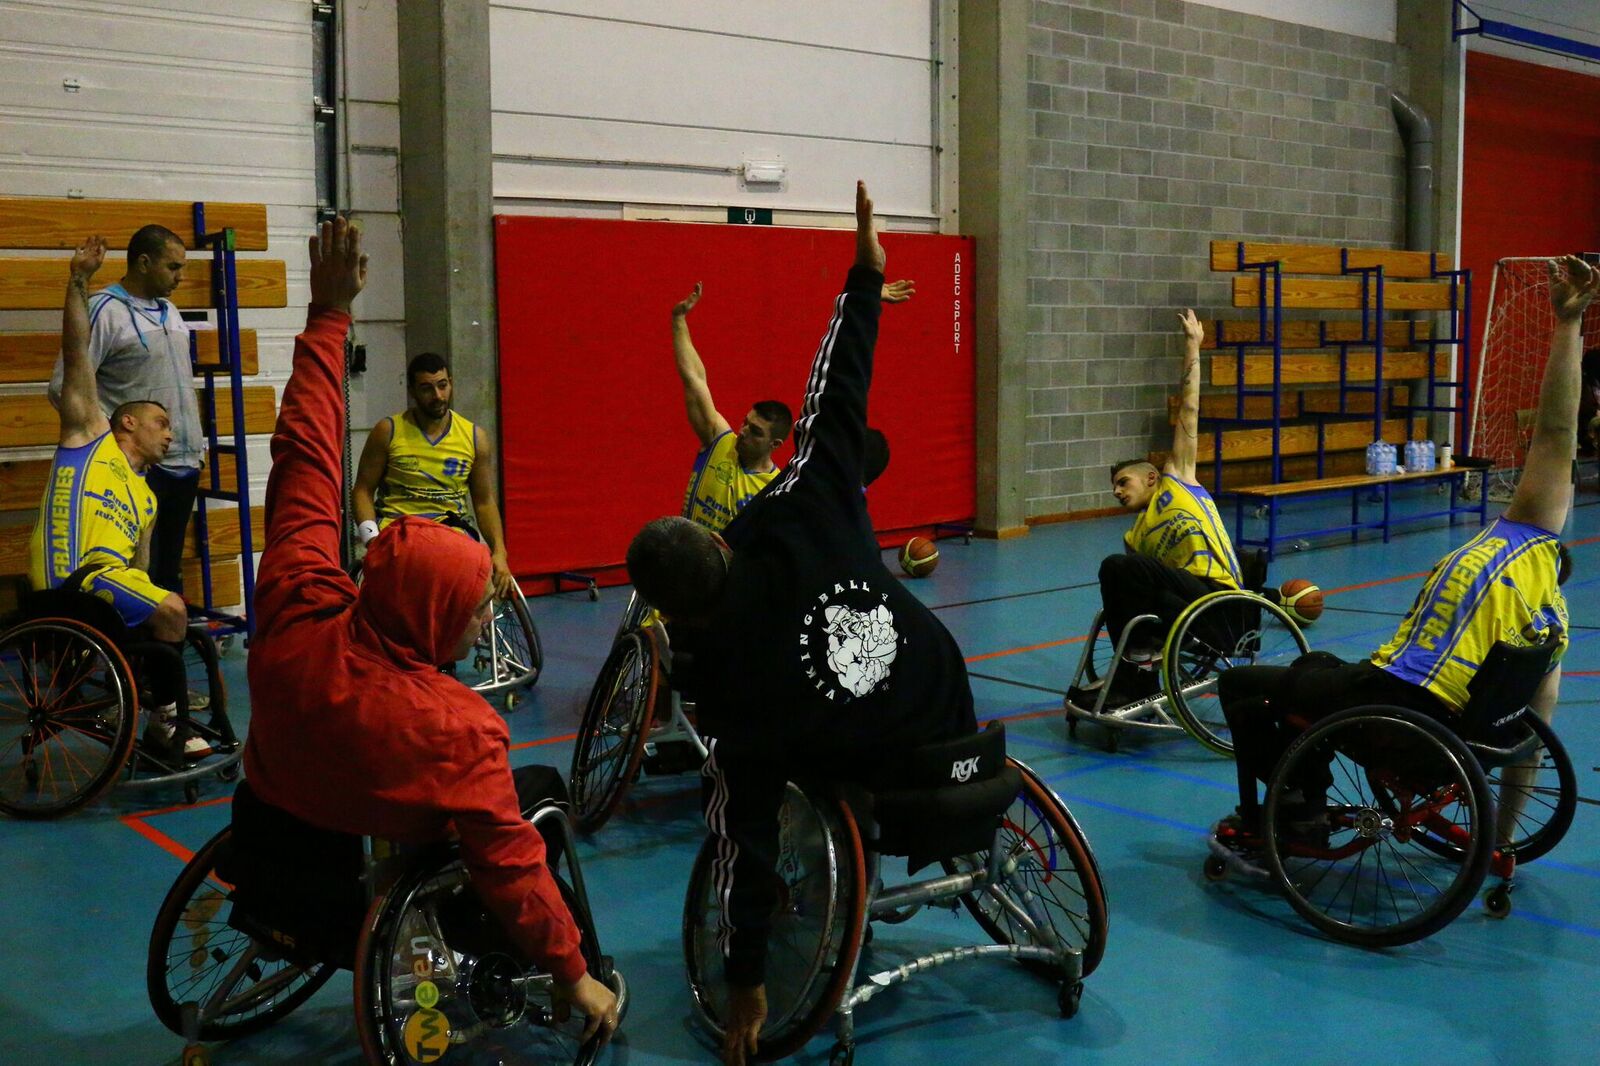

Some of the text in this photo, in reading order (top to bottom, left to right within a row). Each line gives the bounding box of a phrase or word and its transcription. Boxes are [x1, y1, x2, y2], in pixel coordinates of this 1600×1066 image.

[953, 252, 961, 354] ADEC SPORT
[51, 465, 76, 579] FRAMERIES
